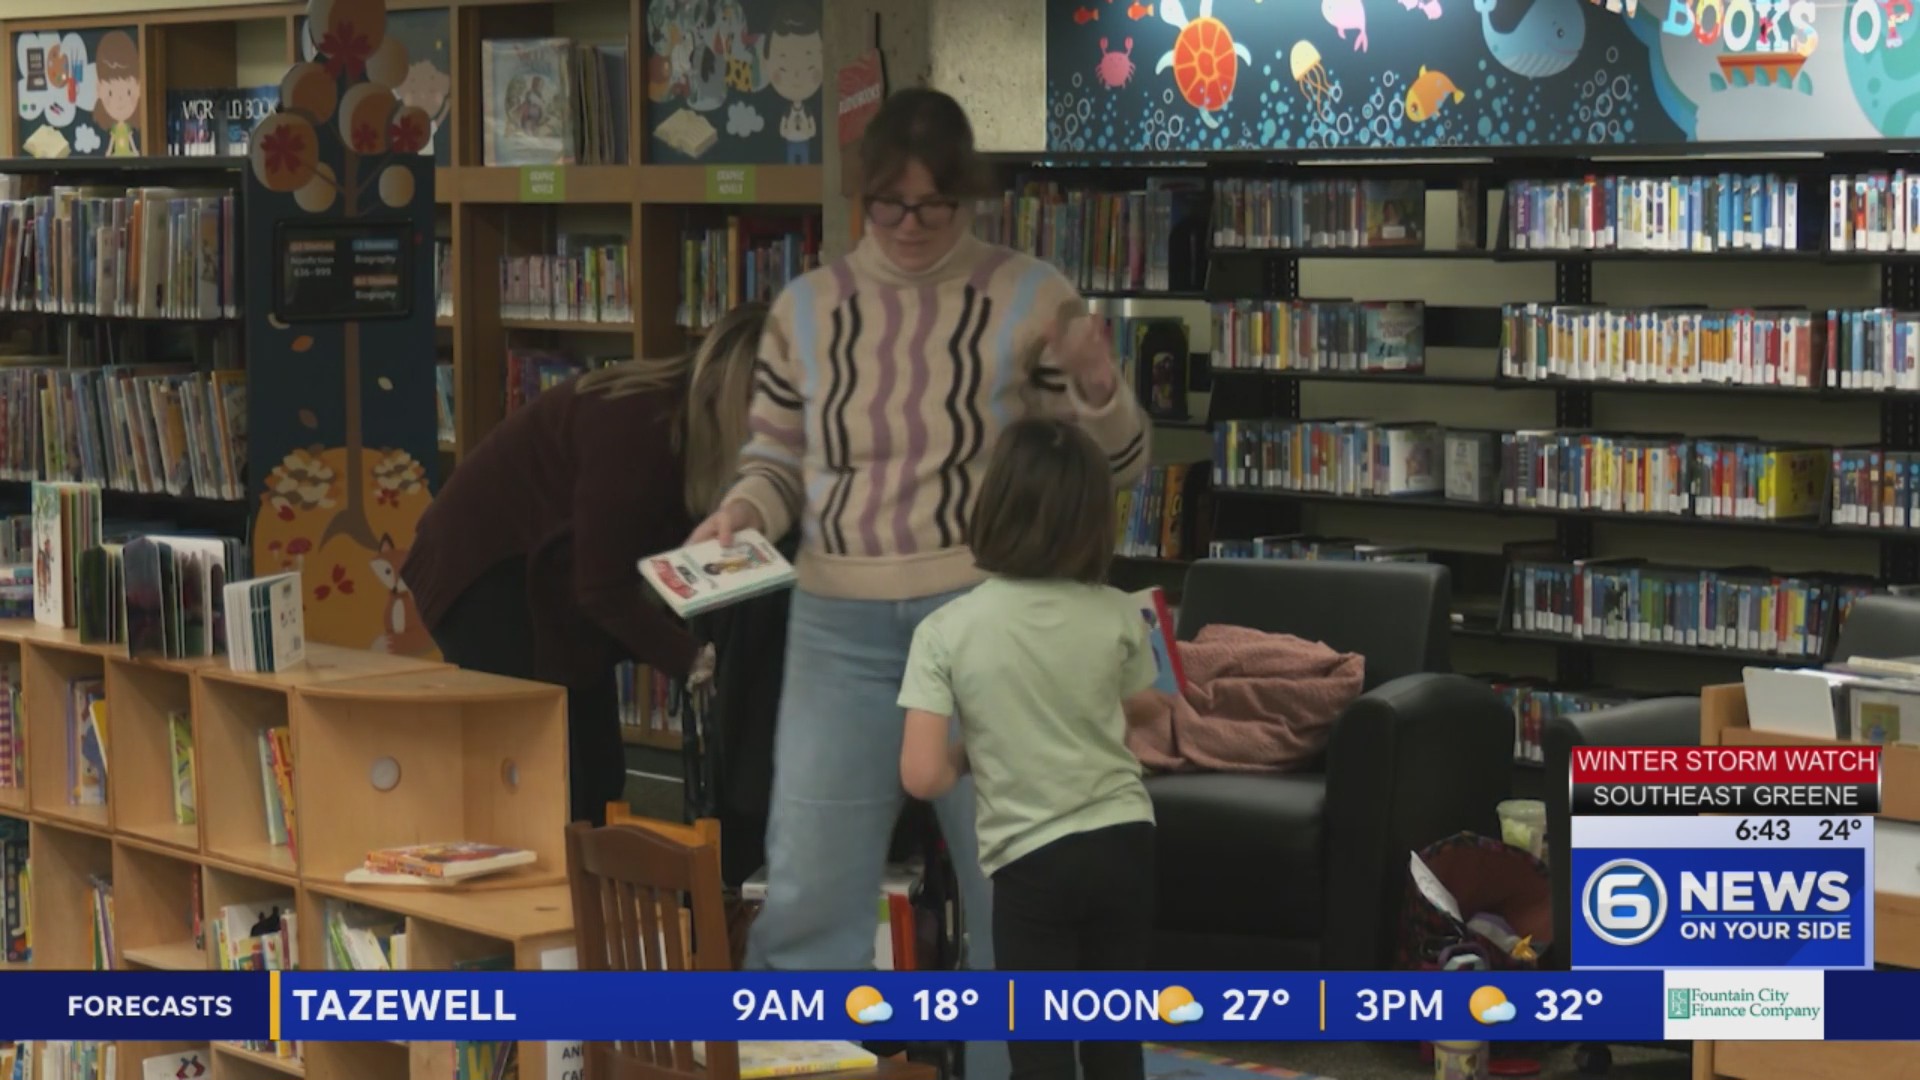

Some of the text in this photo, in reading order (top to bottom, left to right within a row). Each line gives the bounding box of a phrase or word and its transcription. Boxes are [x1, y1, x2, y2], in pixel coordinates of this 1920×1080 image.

[1661, 0, 1818, 57] BOOKS
[354, 254, 396, 265] Biography
[354, 290, 396, 301] Biography
[562, 1045, 584, 1060] AN
[562, 1069, 584, 1080] CA
